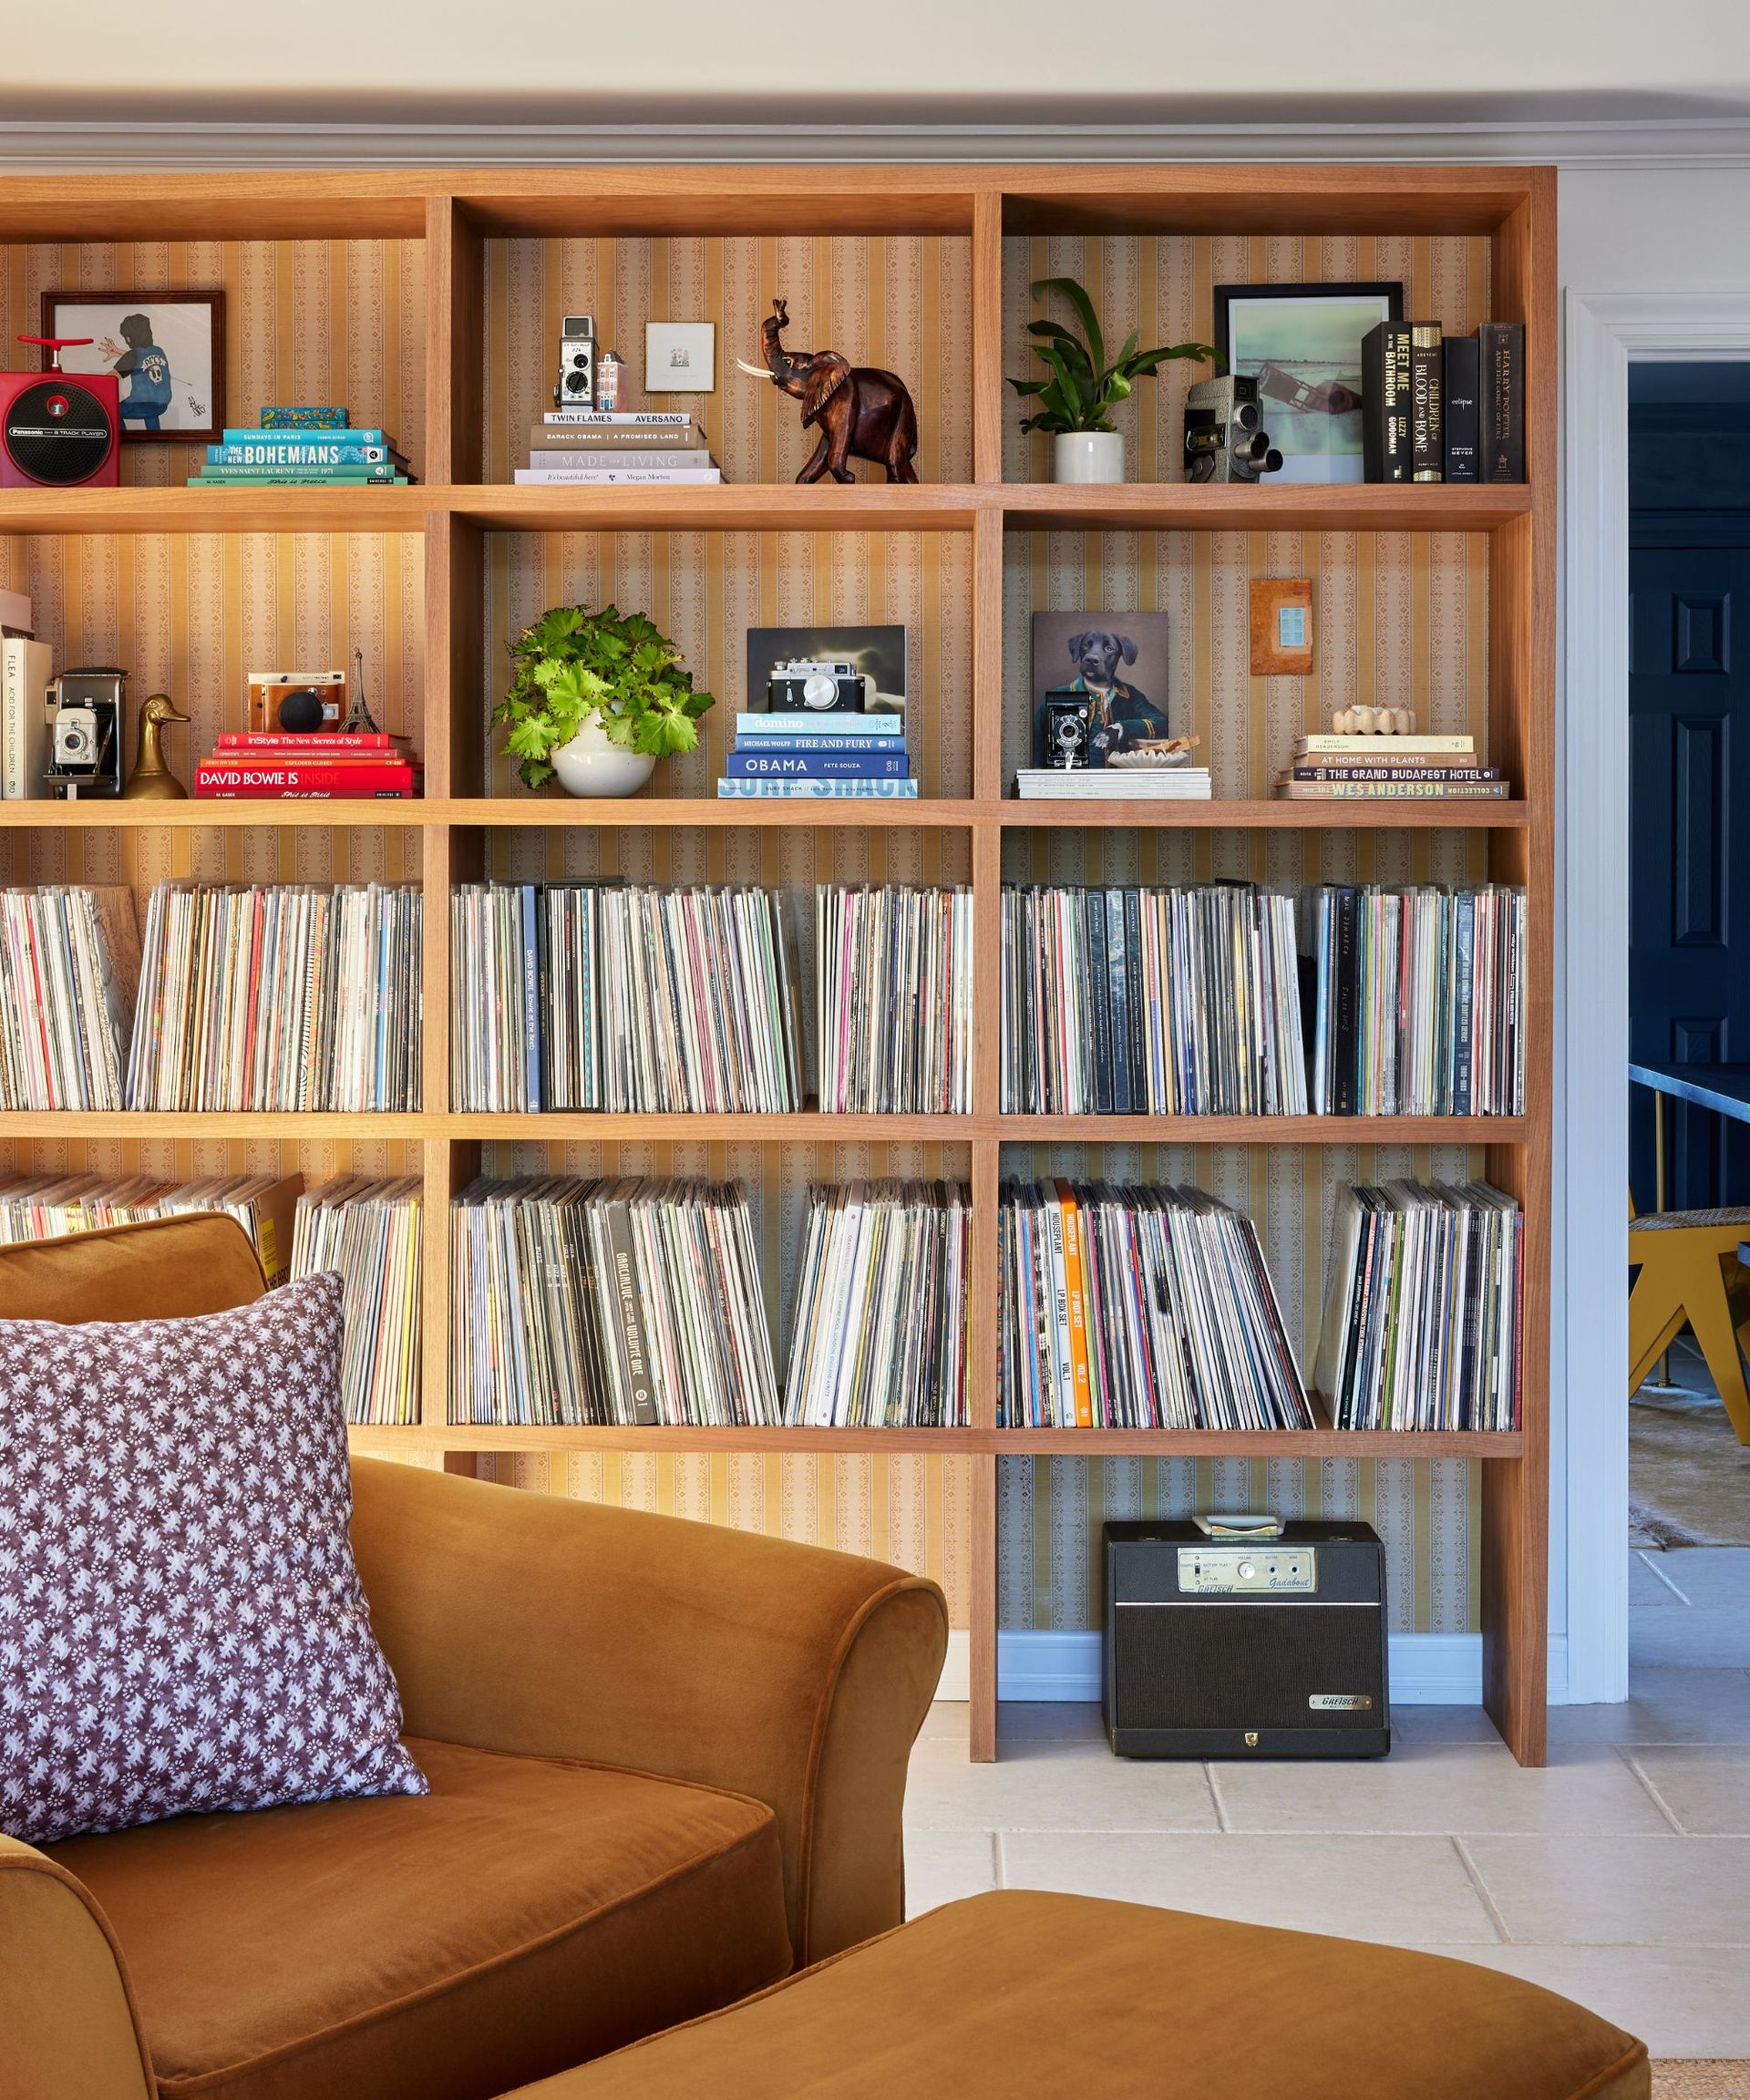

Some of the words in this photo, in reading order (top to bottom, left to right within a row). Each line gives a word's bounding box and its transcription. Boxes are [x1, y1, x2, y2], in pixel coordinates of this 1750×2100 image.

[1396, 334, 1410, 367] MEET
[1385, 351, 1396, 407] BATHROOM
[1502, 350, 1510, 394] HARRY
[1396, 372, 1409, 391] ME
[1415, 365, 1427, 405] BLOOD
[1429, 378, 1440, 431] CHILDREN
[1451, 397, 1473, 410] eclipse
[1502, 397, 1510, 439] POTTER
[1388, 417, 1397, 455] GOODMAN
[1398, 417, 1406, 438] LIZZY
[1415, 420, 1428, 453] BONE
[231, 447, 242, 455] THE
[245, 446, 339, 464] BOHEMIANS
[561, 456, 606, 467] MADE
[623, 456, 677, 467] LIVING
[7, 655, 15, 678] FLEA
[755, 716, 804, 728] domino
[248, 736, 279, 746] InStyle
[281, 736, 294, 745] The
[296, 736, 310, 745] New
[312, 736, 335, 745] Secrets
[336, 736, 345, 745] of
[345, 736, 363, 746] Style
[796, 739, 818, 748] FIRE
[820, 739, 843, 748] AND
[846, 739, 872, 748] FURY
[746, 759, 808, 771] OBAMA
[1329, 769, 1349, 779] THE
[1352, 769, 1388, 779] GRAND
[1392, 769, 1447, 779] BUDAPEST
[1449, 769, 1482, 779] HOTEL
[201, 772, 241, 785] DAVID
[243, 772, 284, 785] BOWIE
[288, 772, 299, 785] IS
[300, 772, 340, 785] INSIDE
[1333, 783, 1364, 797] WES
[1368, 783, 1445, 797] ANDERSON
[1052, 1212, 1062, 1255] HOUSEPLANT
[1066, 1214, 1077, 1256] HOUSEPLANT
[844, 1235, 853, 1259] GRATEFUL
[1365, 1245, 1374, 1271] JOHNSON
[616, 1252, 633, 1300] GARCIALIVE
[1057, 1289, 1065, 1298] LP
[1071, 1291, 1081, 1301] LP
[1363, 1279, 1371, 1296] SLEEP
[1057, 1299, 1066, 1312] BOX
[1072, 1301, 1081, 1314] BOX
[1360, 1298, 1369, 1325] THROUGH
[1058, 1313, 1067, 1326] SET
[1074, 1314, 1082, 1328] SET
[626, 1324, 642, 1358] VOLUME
[830, 1333, 839, 1355] LONDON,
[1357, 1339, 1365, 1358] STATIC
[631, 1359, 643, 1376] ONE
[827, 1355, 836, 1379] ENGLAND
[1062, 1363, 1071, 1381] VOL.1
[1076, 1364, 1086, 1384] VOL.2
[1198, 1584, 1234, 1593] GRETSCH
[1270, 1578, 1310, 1590] Gadabout
[1323, 1696, 1359, 1705] GRETSCH
